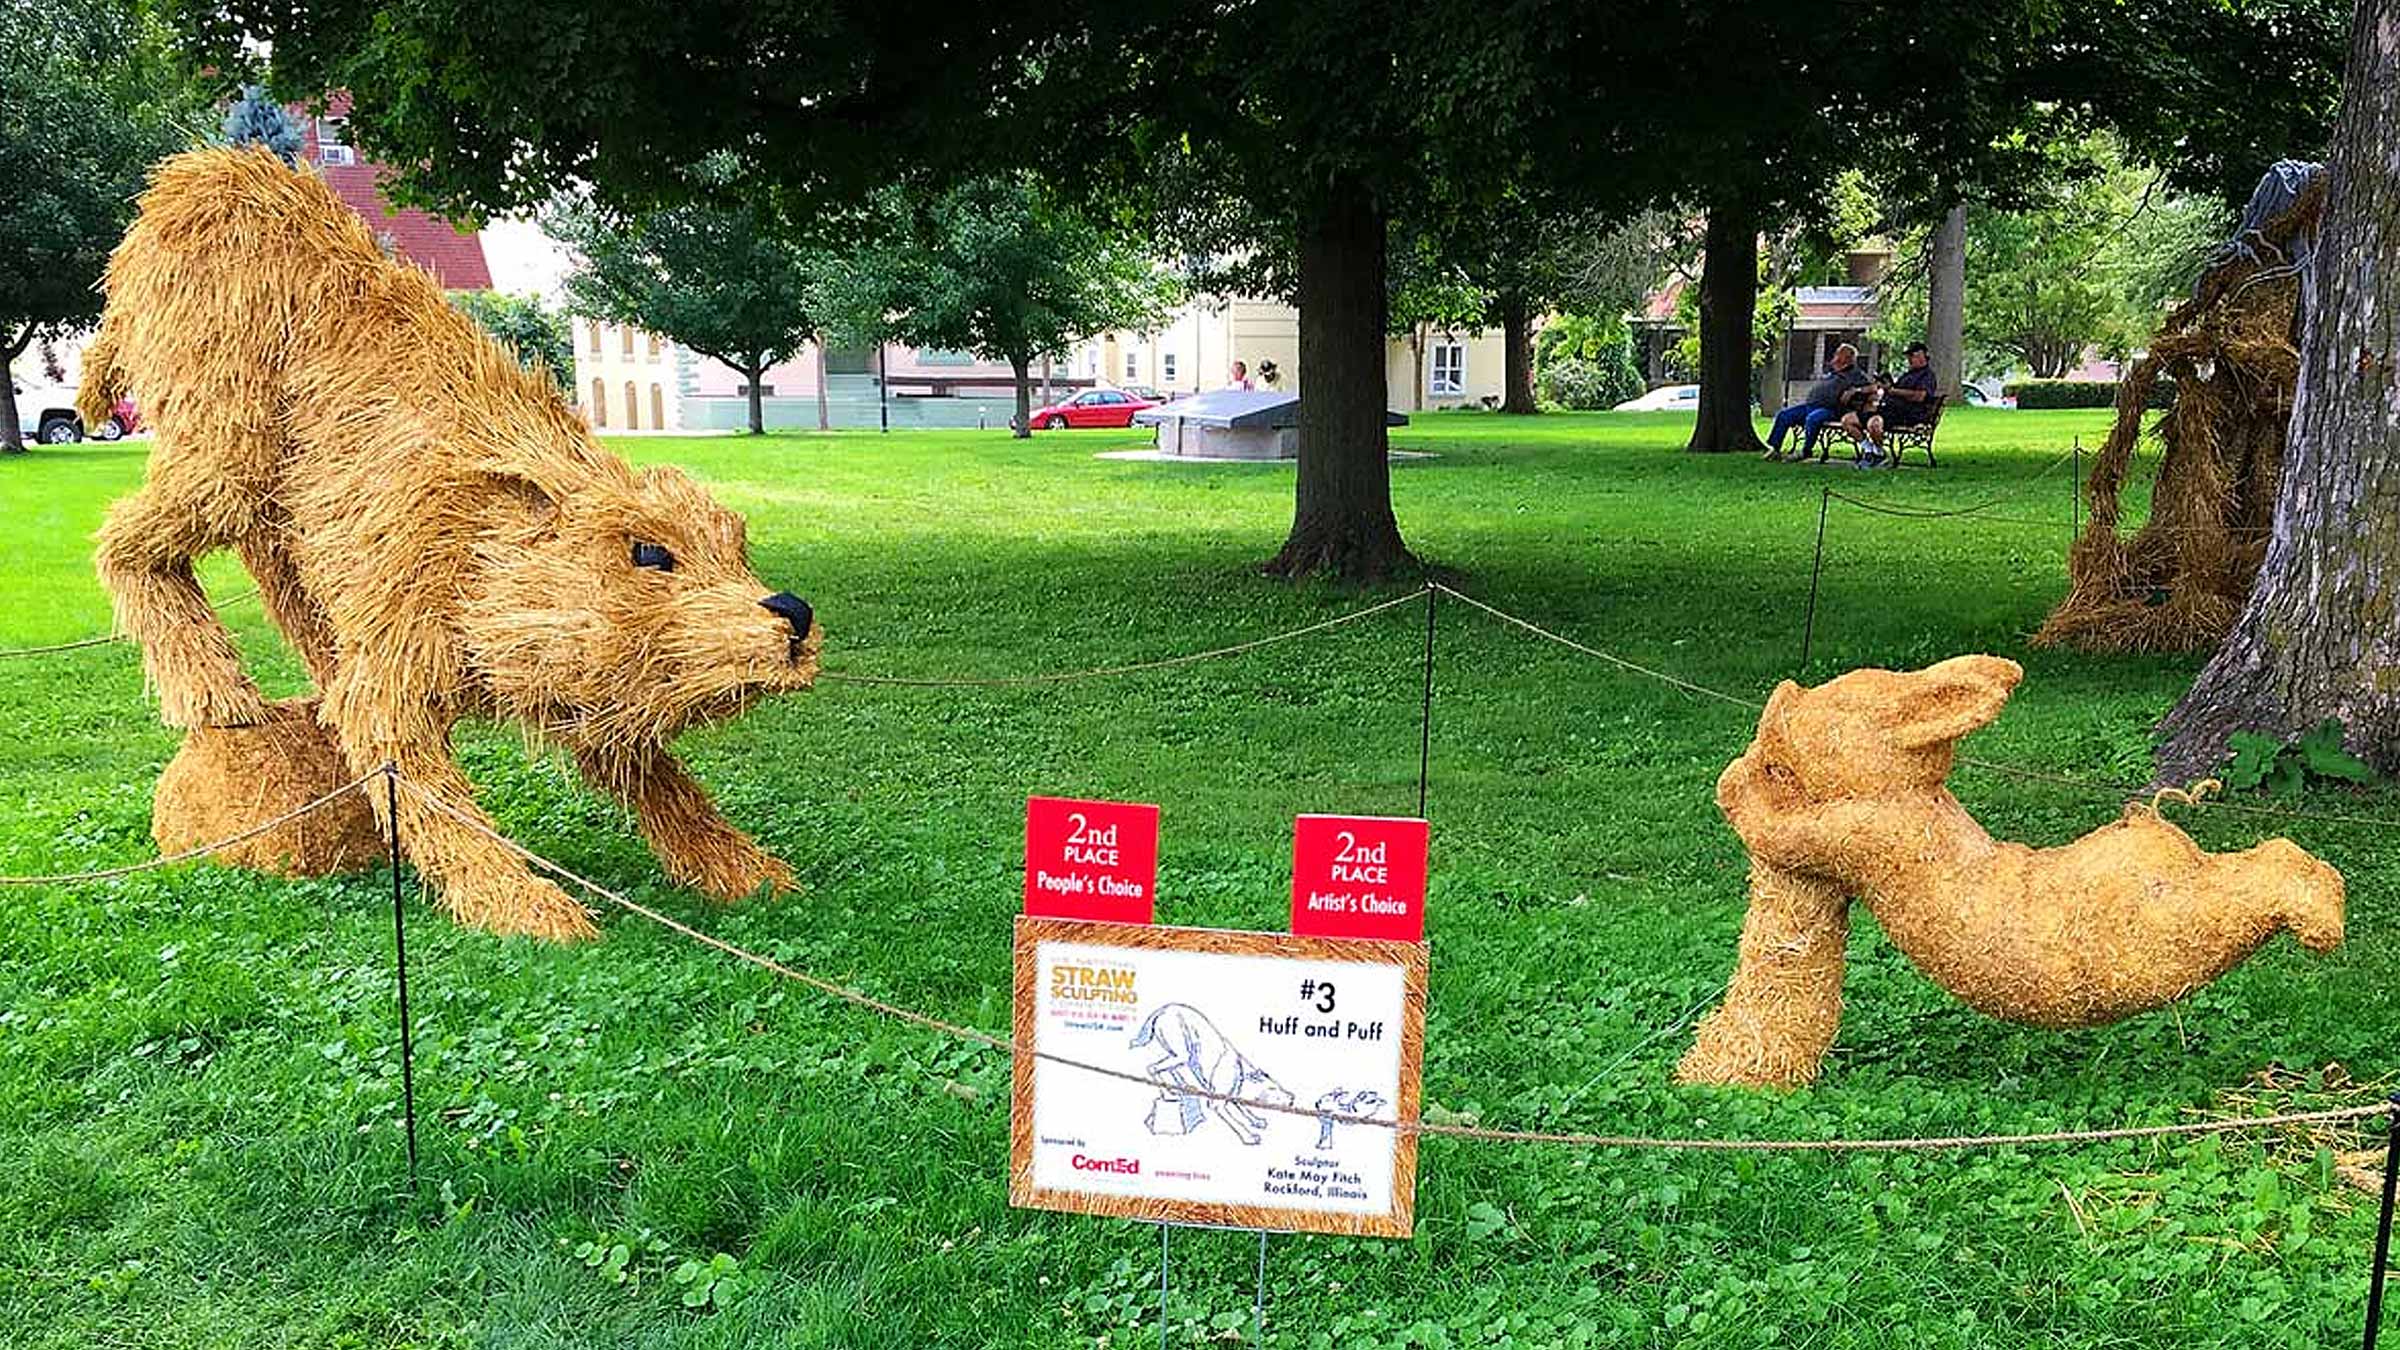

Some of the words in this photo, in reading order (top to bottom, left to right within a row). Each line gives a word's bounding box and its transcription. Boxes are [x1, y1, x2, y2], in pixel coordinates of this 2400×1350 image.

[1067, 813, 1117, 846] 2nd
[1064, 846, 1118, 866] PLACE
[1334, 831, 1386, 864] 2nd
[1037, 870, 1094, 895] People's
[1098, 875, 1142, 898] Choice
[1331, 864, 1387, 884] PLACE
[1308, 891, 1357, 912] Artist's
[1361, 893, 1407, 915] Choice
[1051, 965, 1136, 989] STRAW
[1300, 979, 1335, 1013] #3
[1259, 1016, 1299, 1035] Huff
[1305, 1020, 1340, 1038] and
[1347, 1021, 1383, 1041] Puff
[1072, 1154, 1140, 1175] ComEd
[1268, 1168, 1296, 1180] Kate
[1300, 1170, 1328, 1185] May
[1332, 1171, 1361, 1184] Fitch
[1264, 1181, 1323, 1199] Rockford,
